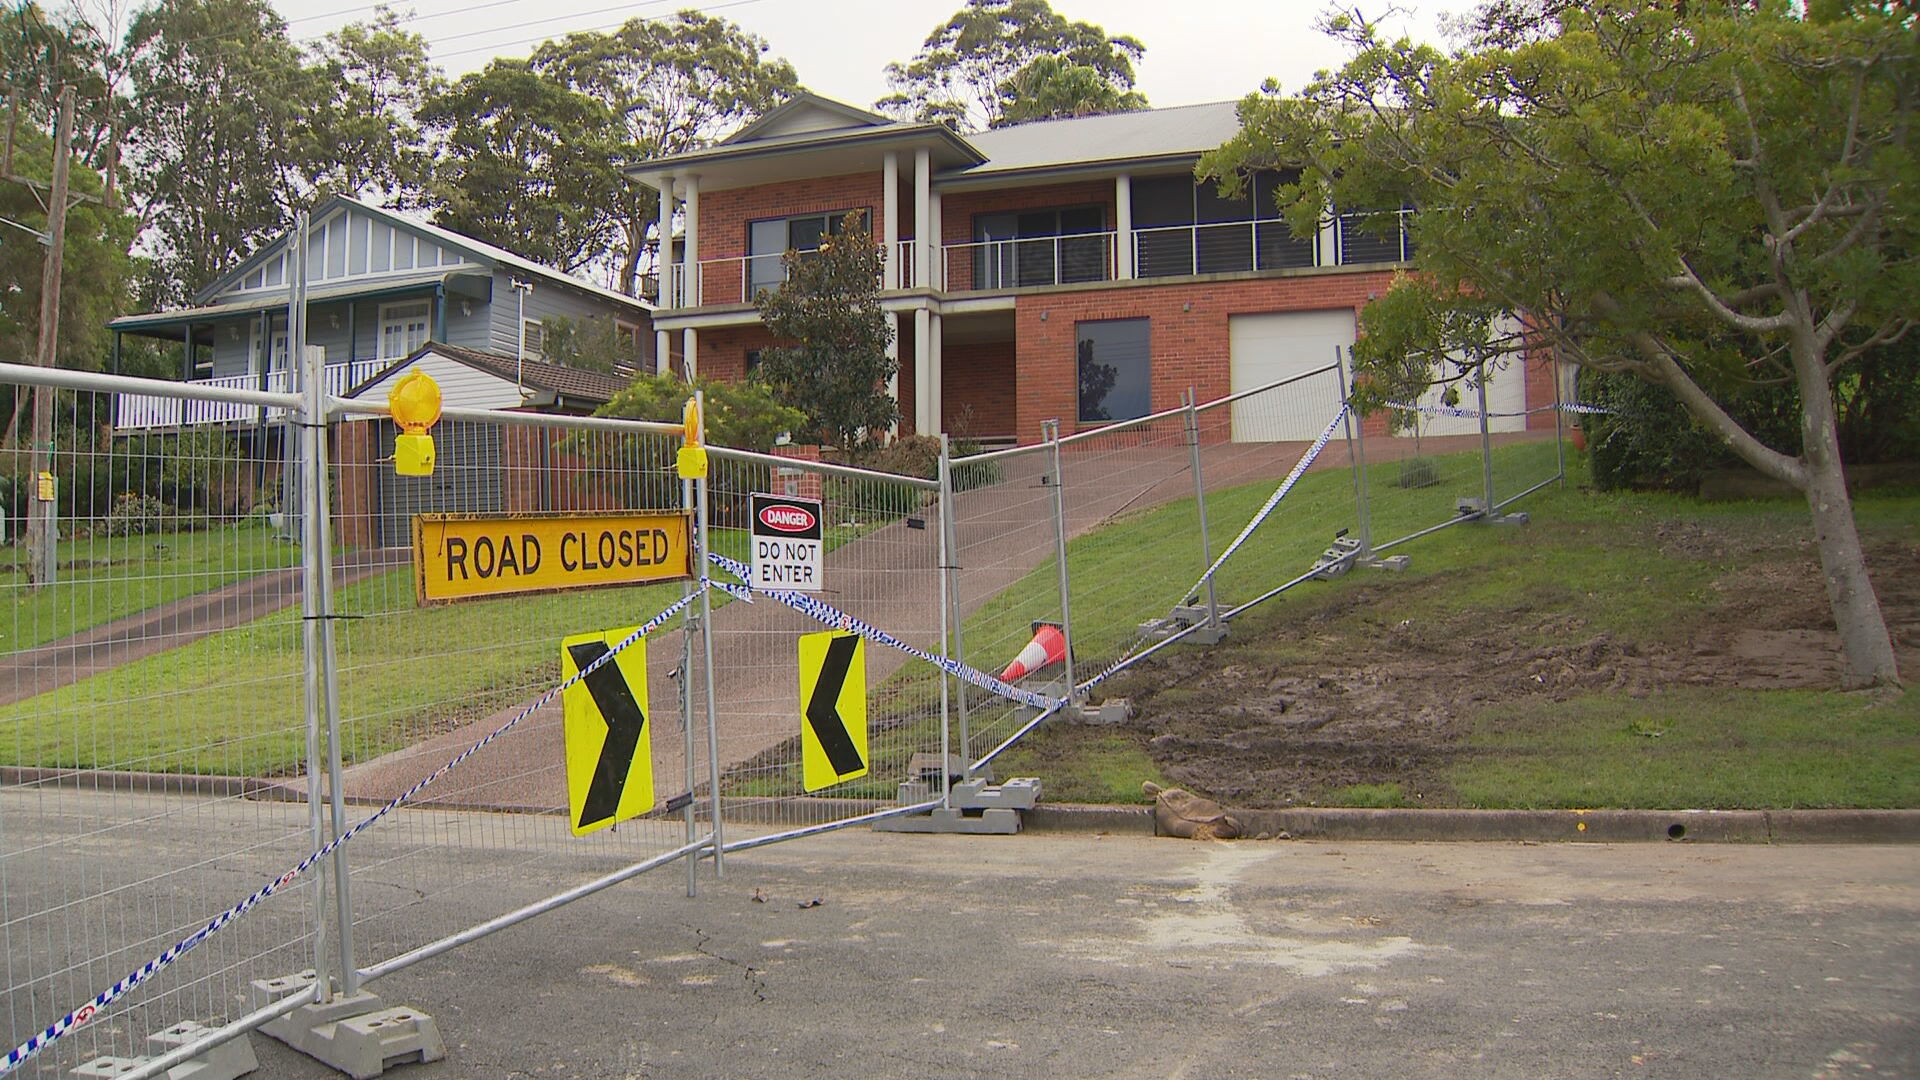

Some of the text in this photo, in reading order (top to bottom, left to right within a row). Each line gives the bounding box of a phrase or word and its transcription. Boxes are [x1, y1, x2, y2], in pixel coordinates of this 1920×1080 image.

[767, 509, 808, 526] DANGER
[447, 529, 668, 581] ROAD CLOSED
[759, 541, 816, 561] DO NOT
[762, 564, 813, 582] ENTER
